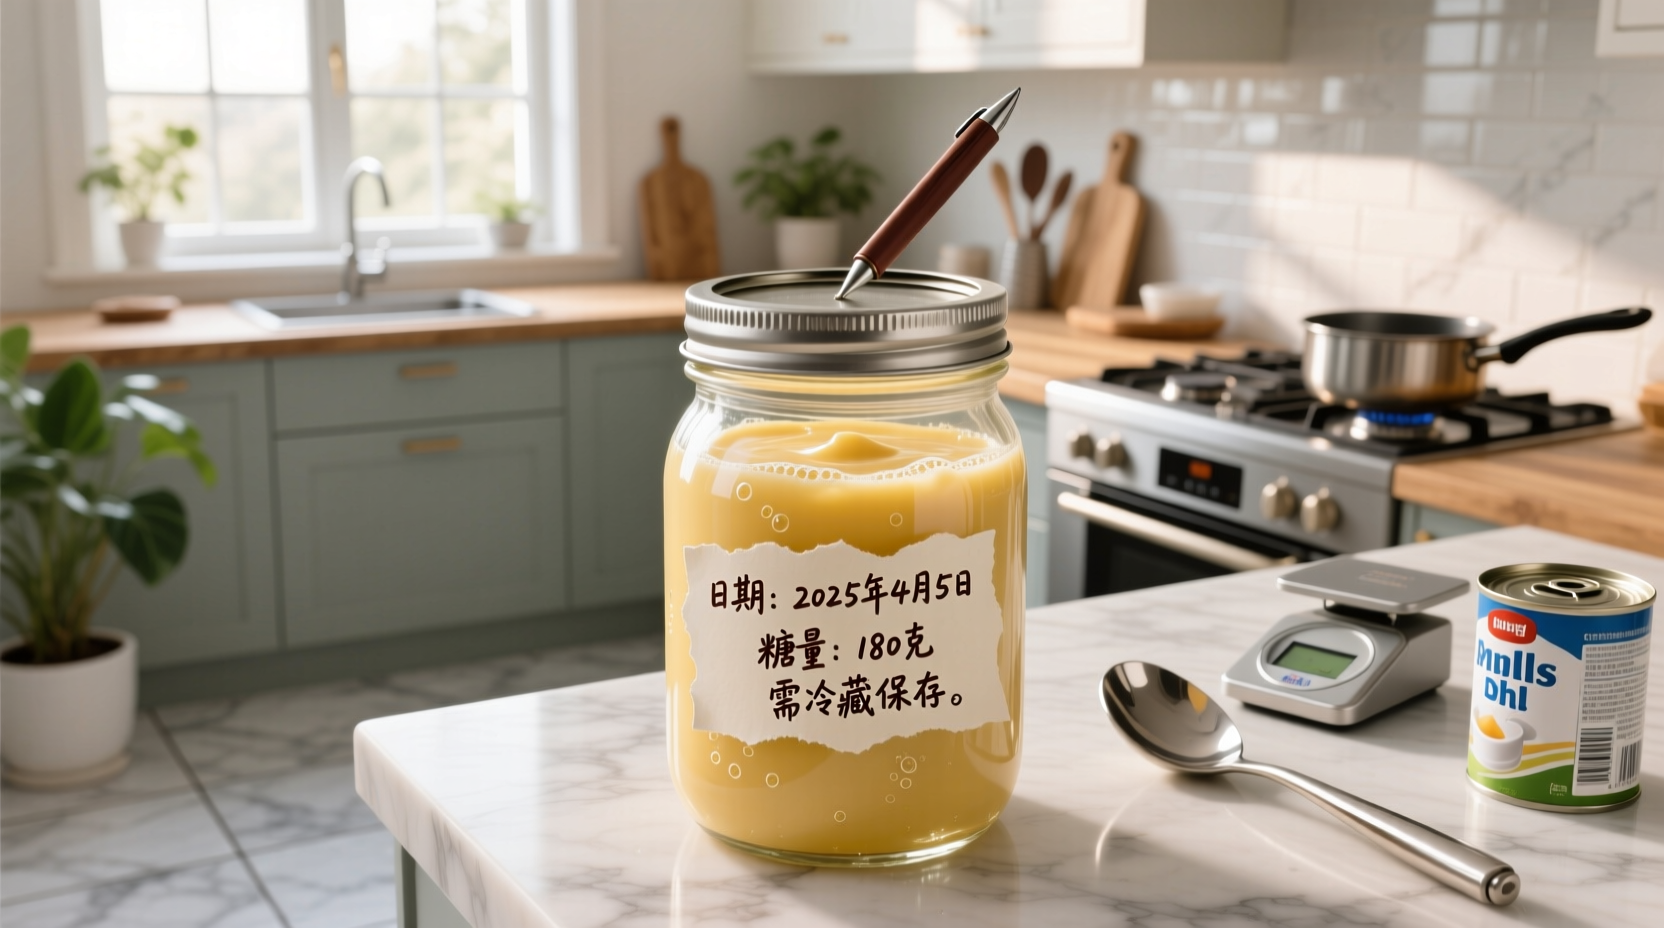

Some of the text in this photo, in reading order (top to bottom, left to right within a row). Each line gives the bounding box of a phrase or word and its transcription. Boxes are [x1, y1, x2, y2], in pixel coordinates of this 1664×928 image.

[769, 671, 963, 722] 需冷藏保存。
